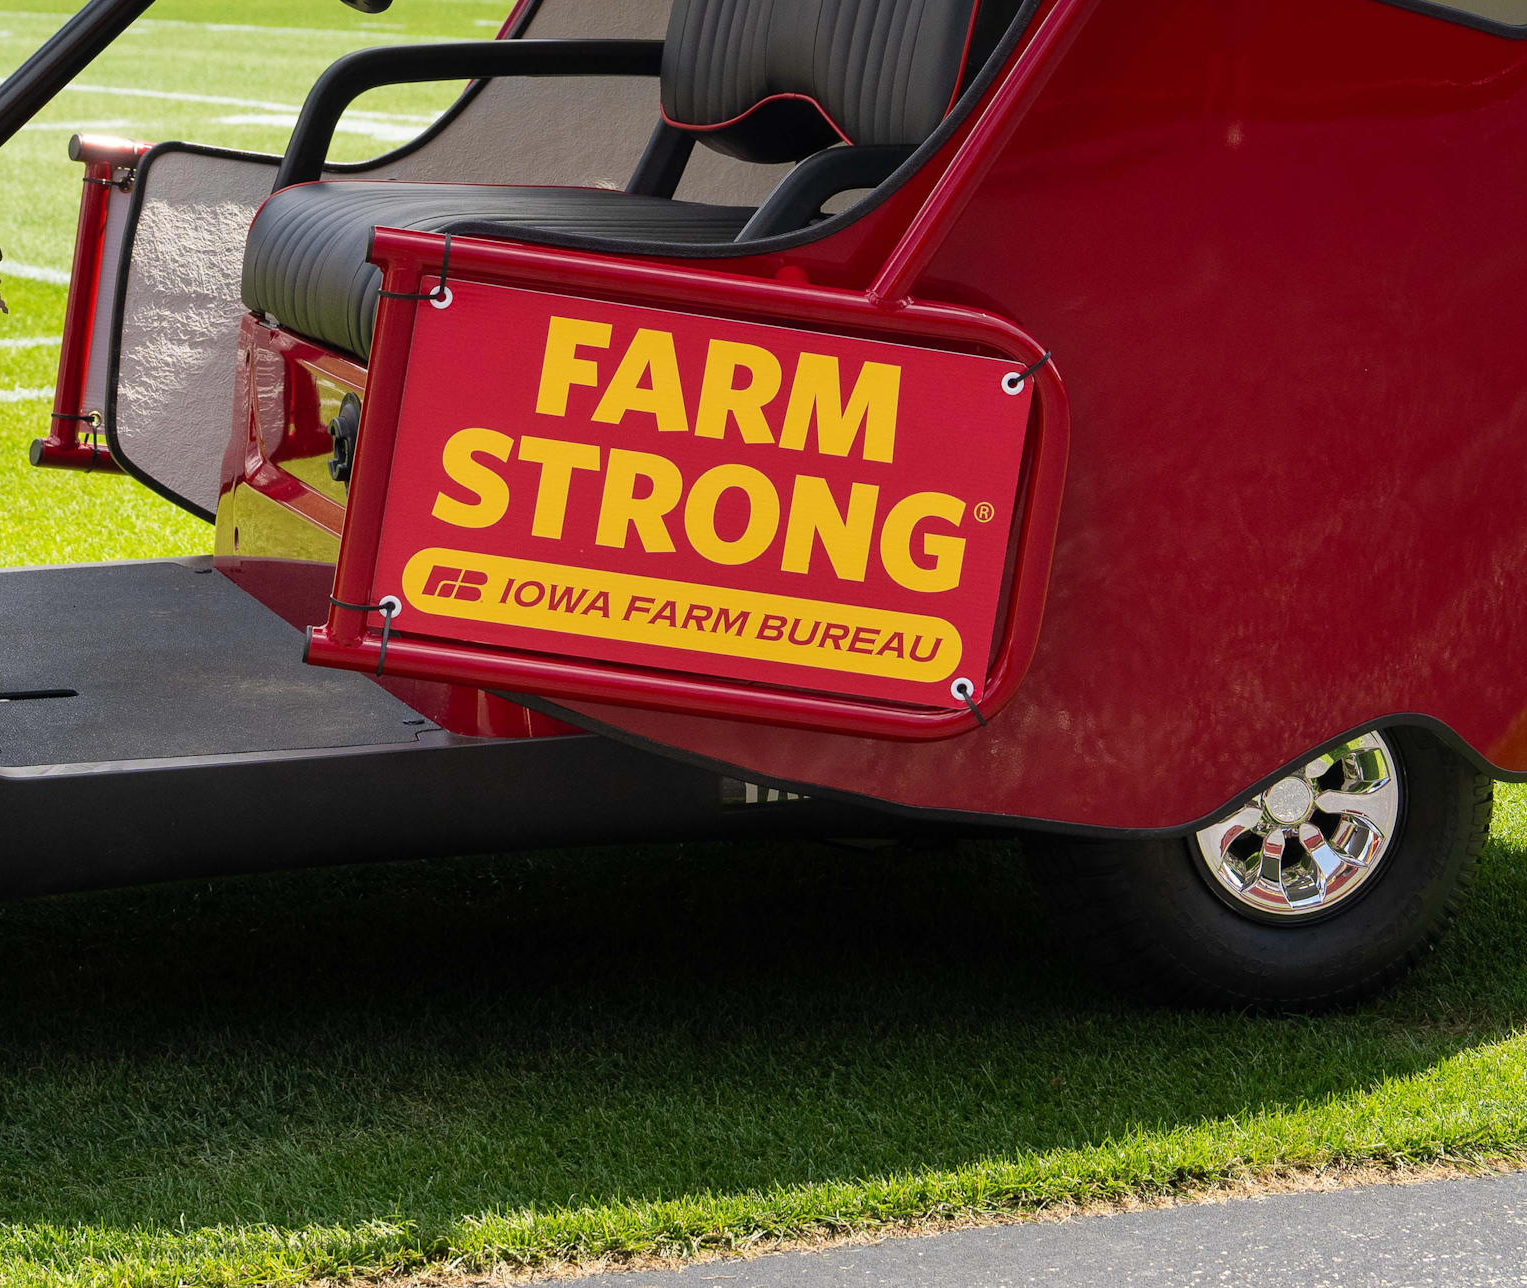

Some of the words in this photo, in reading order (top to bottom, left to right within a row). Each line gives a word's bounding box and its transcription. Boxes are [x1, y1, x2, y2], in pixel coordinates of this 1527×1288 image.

[534, 316, 902, 464] FARM
[498, 578, 611, 619] IOWA
[621, 594, 753, 637] FARM
[755, 613, 944, 664] BUREAU
